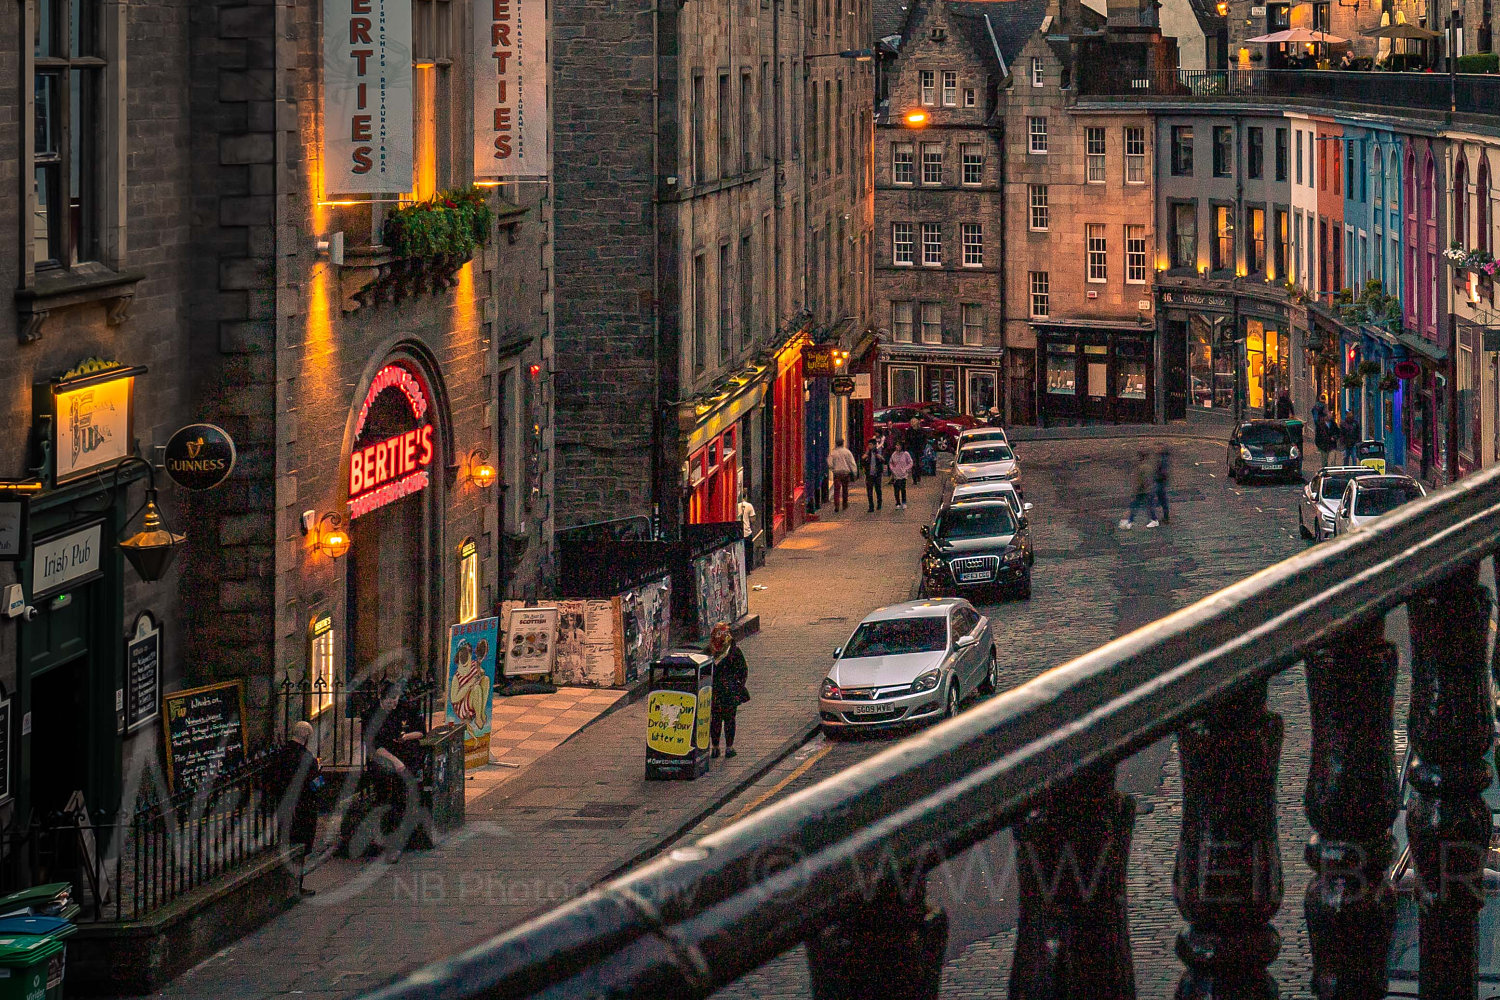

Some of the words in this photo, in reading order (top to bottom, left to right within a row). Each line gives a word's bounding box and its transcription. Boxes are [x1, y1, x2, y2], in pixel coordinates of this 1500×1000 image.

[167, 458, 225, 471] GUINNESS
[350, 424, 433, 495] BERTIE'S
[44, 548, 68, 577] Irish
[72, 538, 91, 567] Pub
[453, 619, 496, 636] BERTIE'S
[648, 718, 669, 730] Drop
